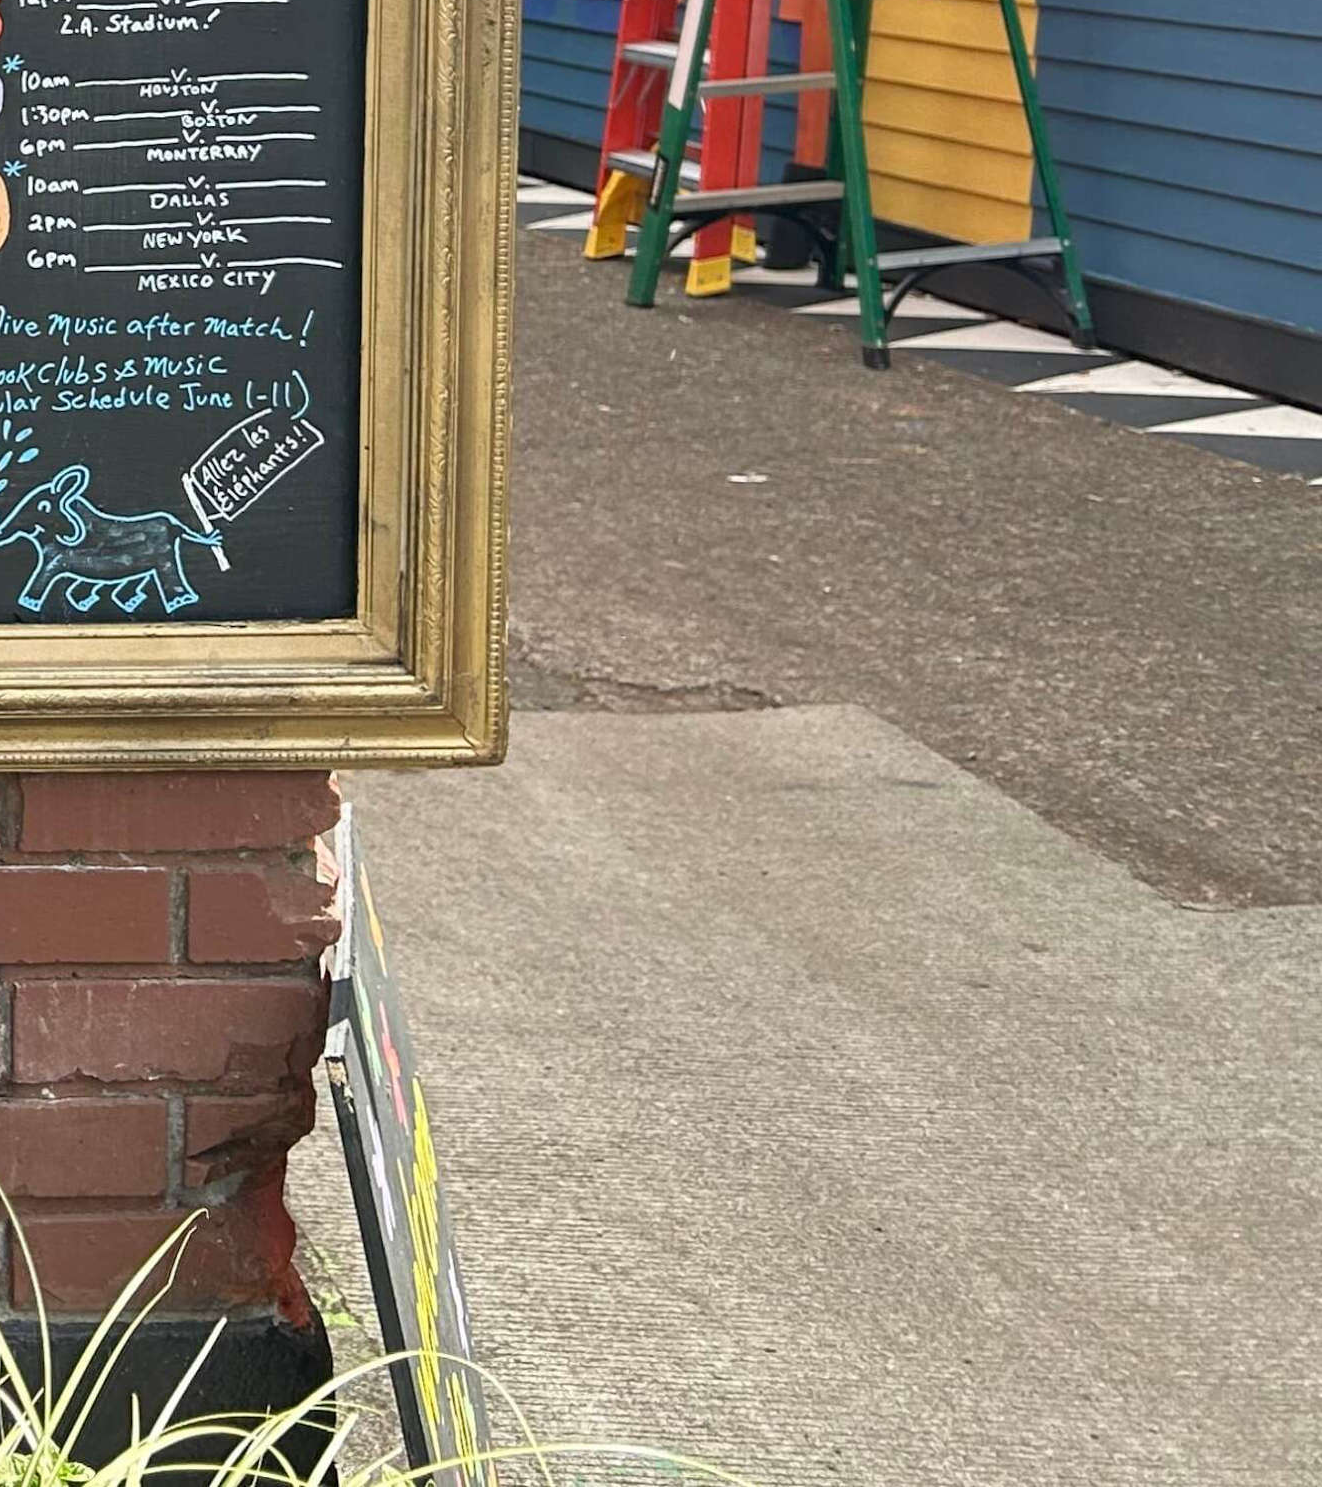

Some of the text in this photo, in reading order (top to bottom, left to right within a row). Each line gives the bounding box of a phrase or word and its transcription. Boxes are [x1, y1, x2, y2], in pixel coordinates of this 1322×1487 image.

[138, 79, 219, 99] HOUSTON
[180, 113, 258, 129] BOSTON
[146, 143, 263, 162] MONTERRAY
[149, 191, 230, 210] DALLAS
[142, 226, 249, 249] NEW YORK
[137, 269, 276, 295] MEXICO CITY
[126, 312, 196, 342] after
[178, 382, 233, 411] June
[201, 425, 270, 487] Allez les
